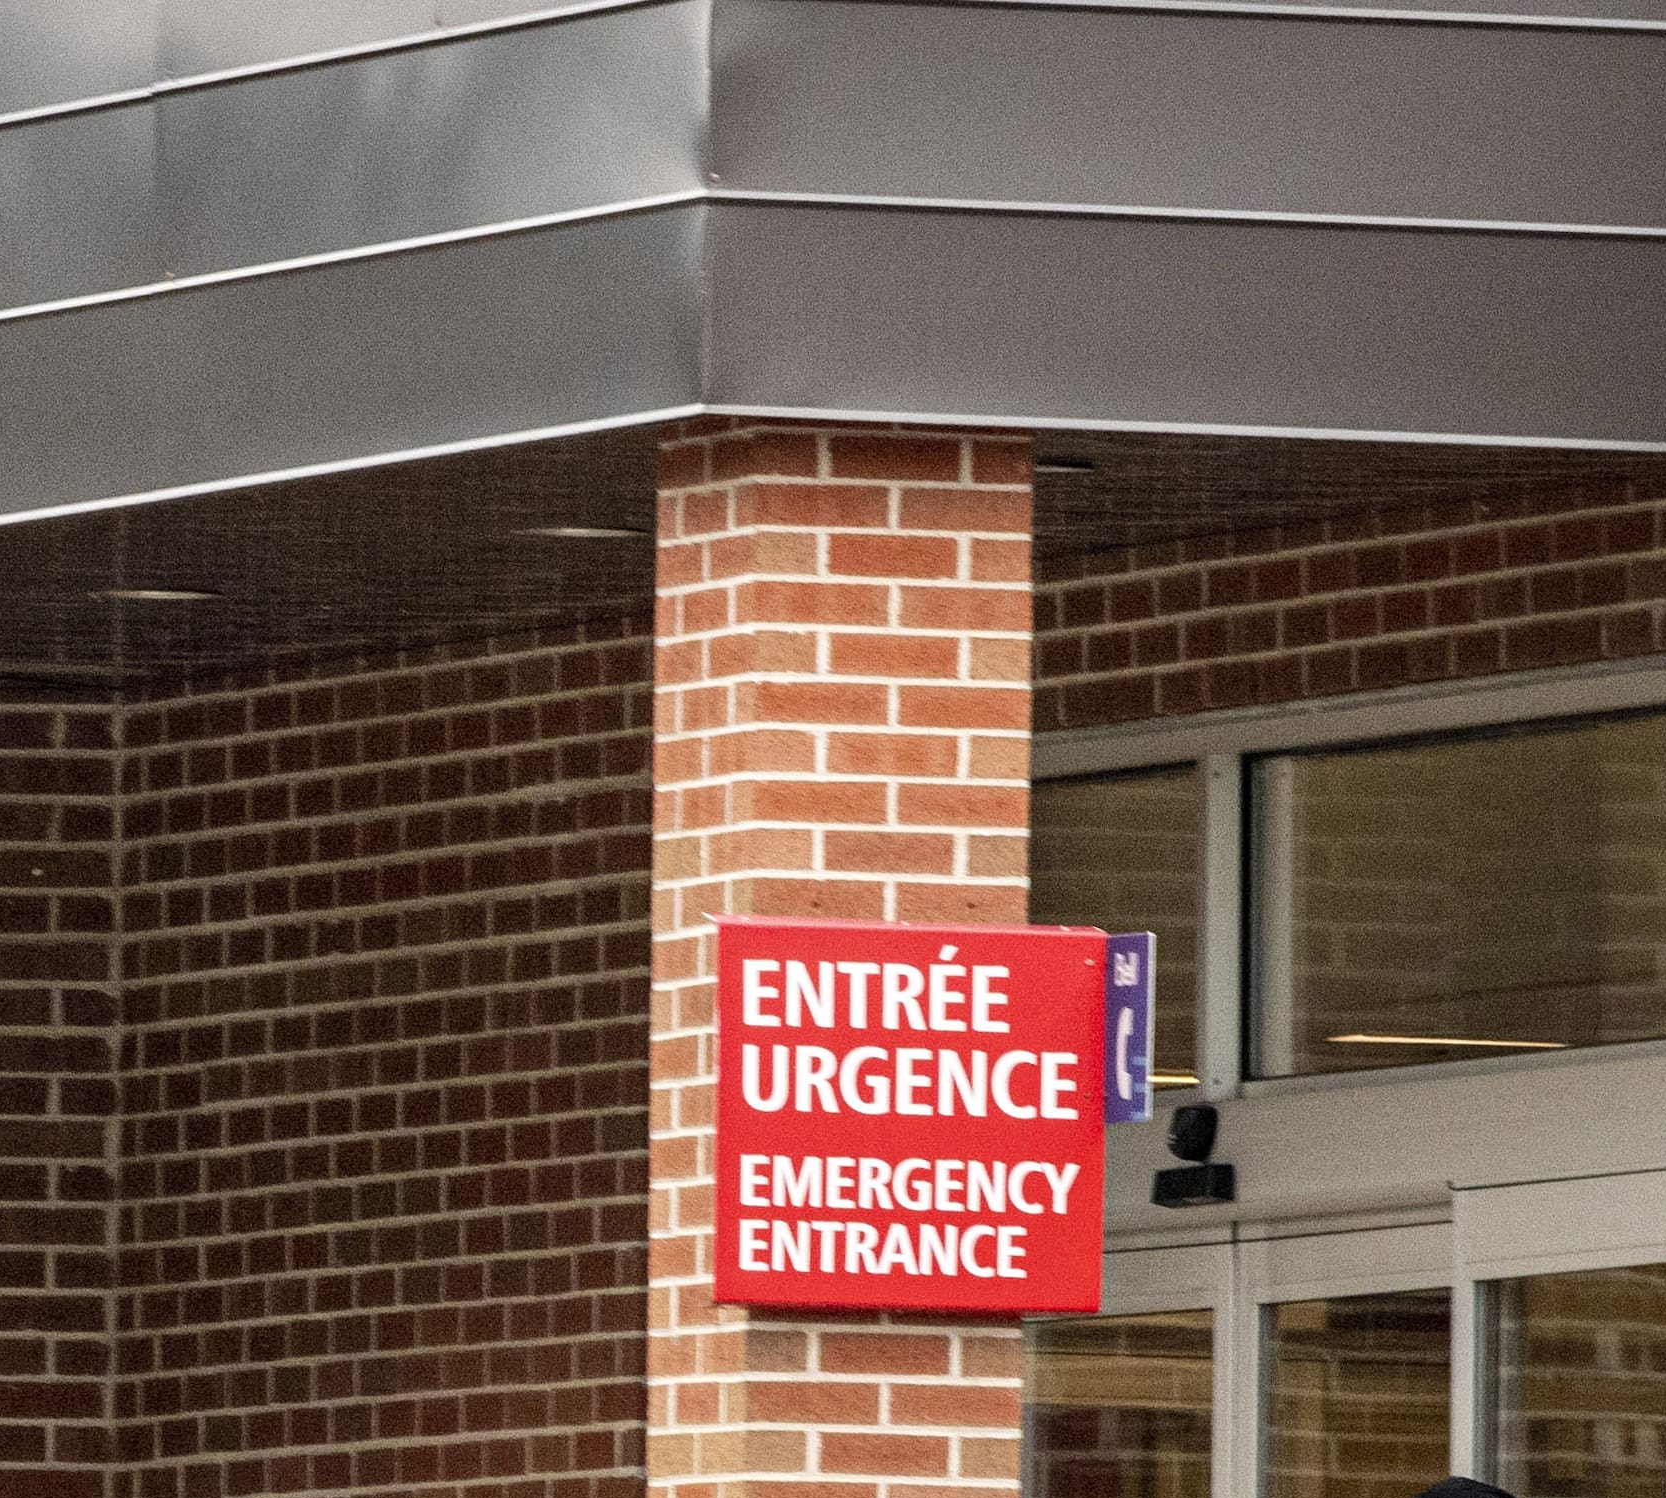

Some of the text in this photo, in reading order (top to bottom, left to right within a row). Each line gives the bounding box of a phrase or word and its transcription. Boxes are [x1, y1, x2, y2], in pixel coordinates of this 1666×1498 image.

[743, 945, 1009, 1033] ENTRÉE
[743, 1044, 1078, 1119] URGENCE
[740, 1155, 1080, 1214] EMERGENCY
[739, 1219, 1027, 1278] ENTRANCE
